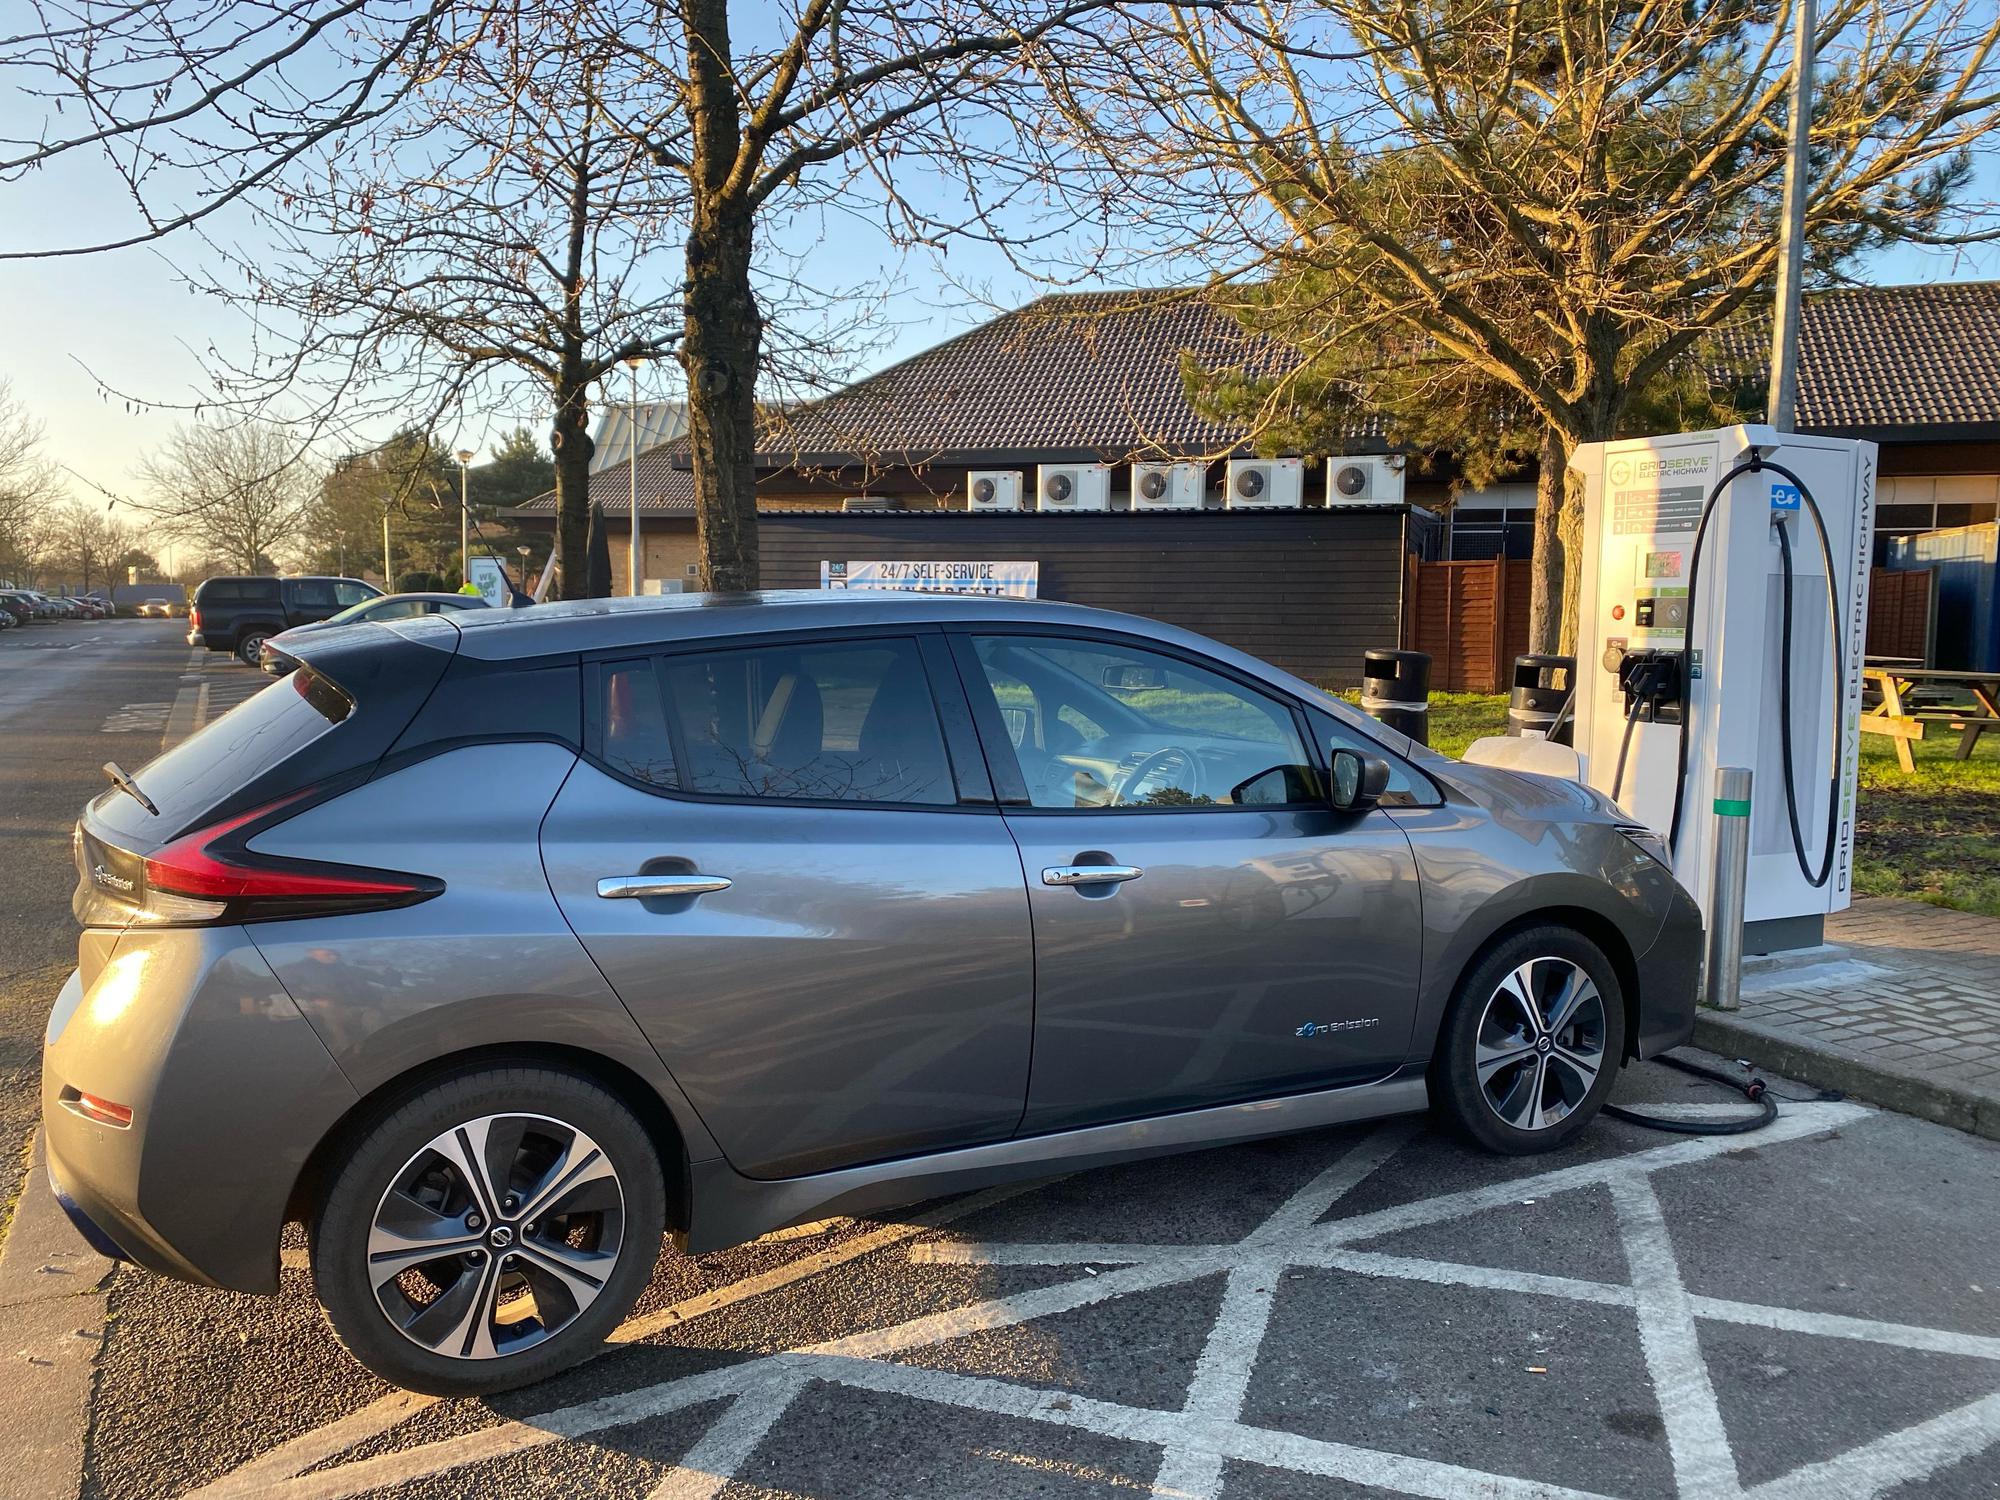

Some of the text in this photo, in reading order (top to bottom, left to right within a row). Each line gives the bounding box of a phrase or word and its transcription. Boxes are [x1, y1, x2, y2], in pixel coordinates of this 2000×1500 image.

[1640, 457, 1709, 471] GRIDSERVE
[1640, 467, 1709, 479] ELECTRIC HIGHWAY
[881, 563, 993, 579] 24/7 SELF-SERVICE
[1839, 456, 1872, 892] GRIDSERVE ELECTRIC HIGHWAY
[1330, 1018, 1380, 1032] Emission
